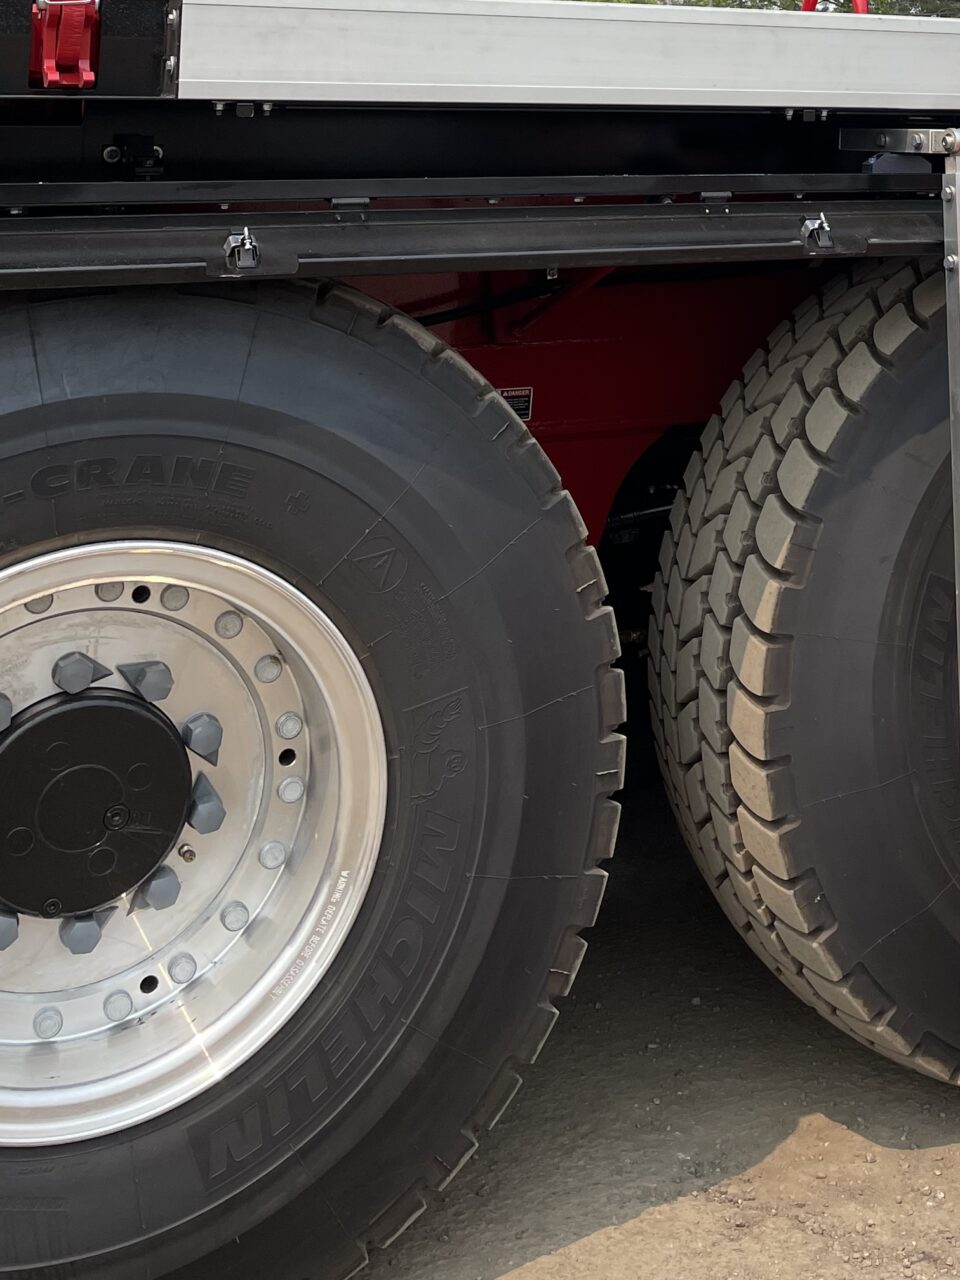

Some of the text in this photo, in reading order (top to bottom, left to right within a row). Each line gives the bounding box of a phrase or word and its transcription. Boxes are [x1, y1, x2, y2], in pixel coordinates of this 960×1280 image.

[331, 870, 350, 903] WARNING
[315, 904, 337, 934] DEFLATE
[301, 934, 321, 959] BEFORE
[209, 807, 461, 1179] MICHELIN
